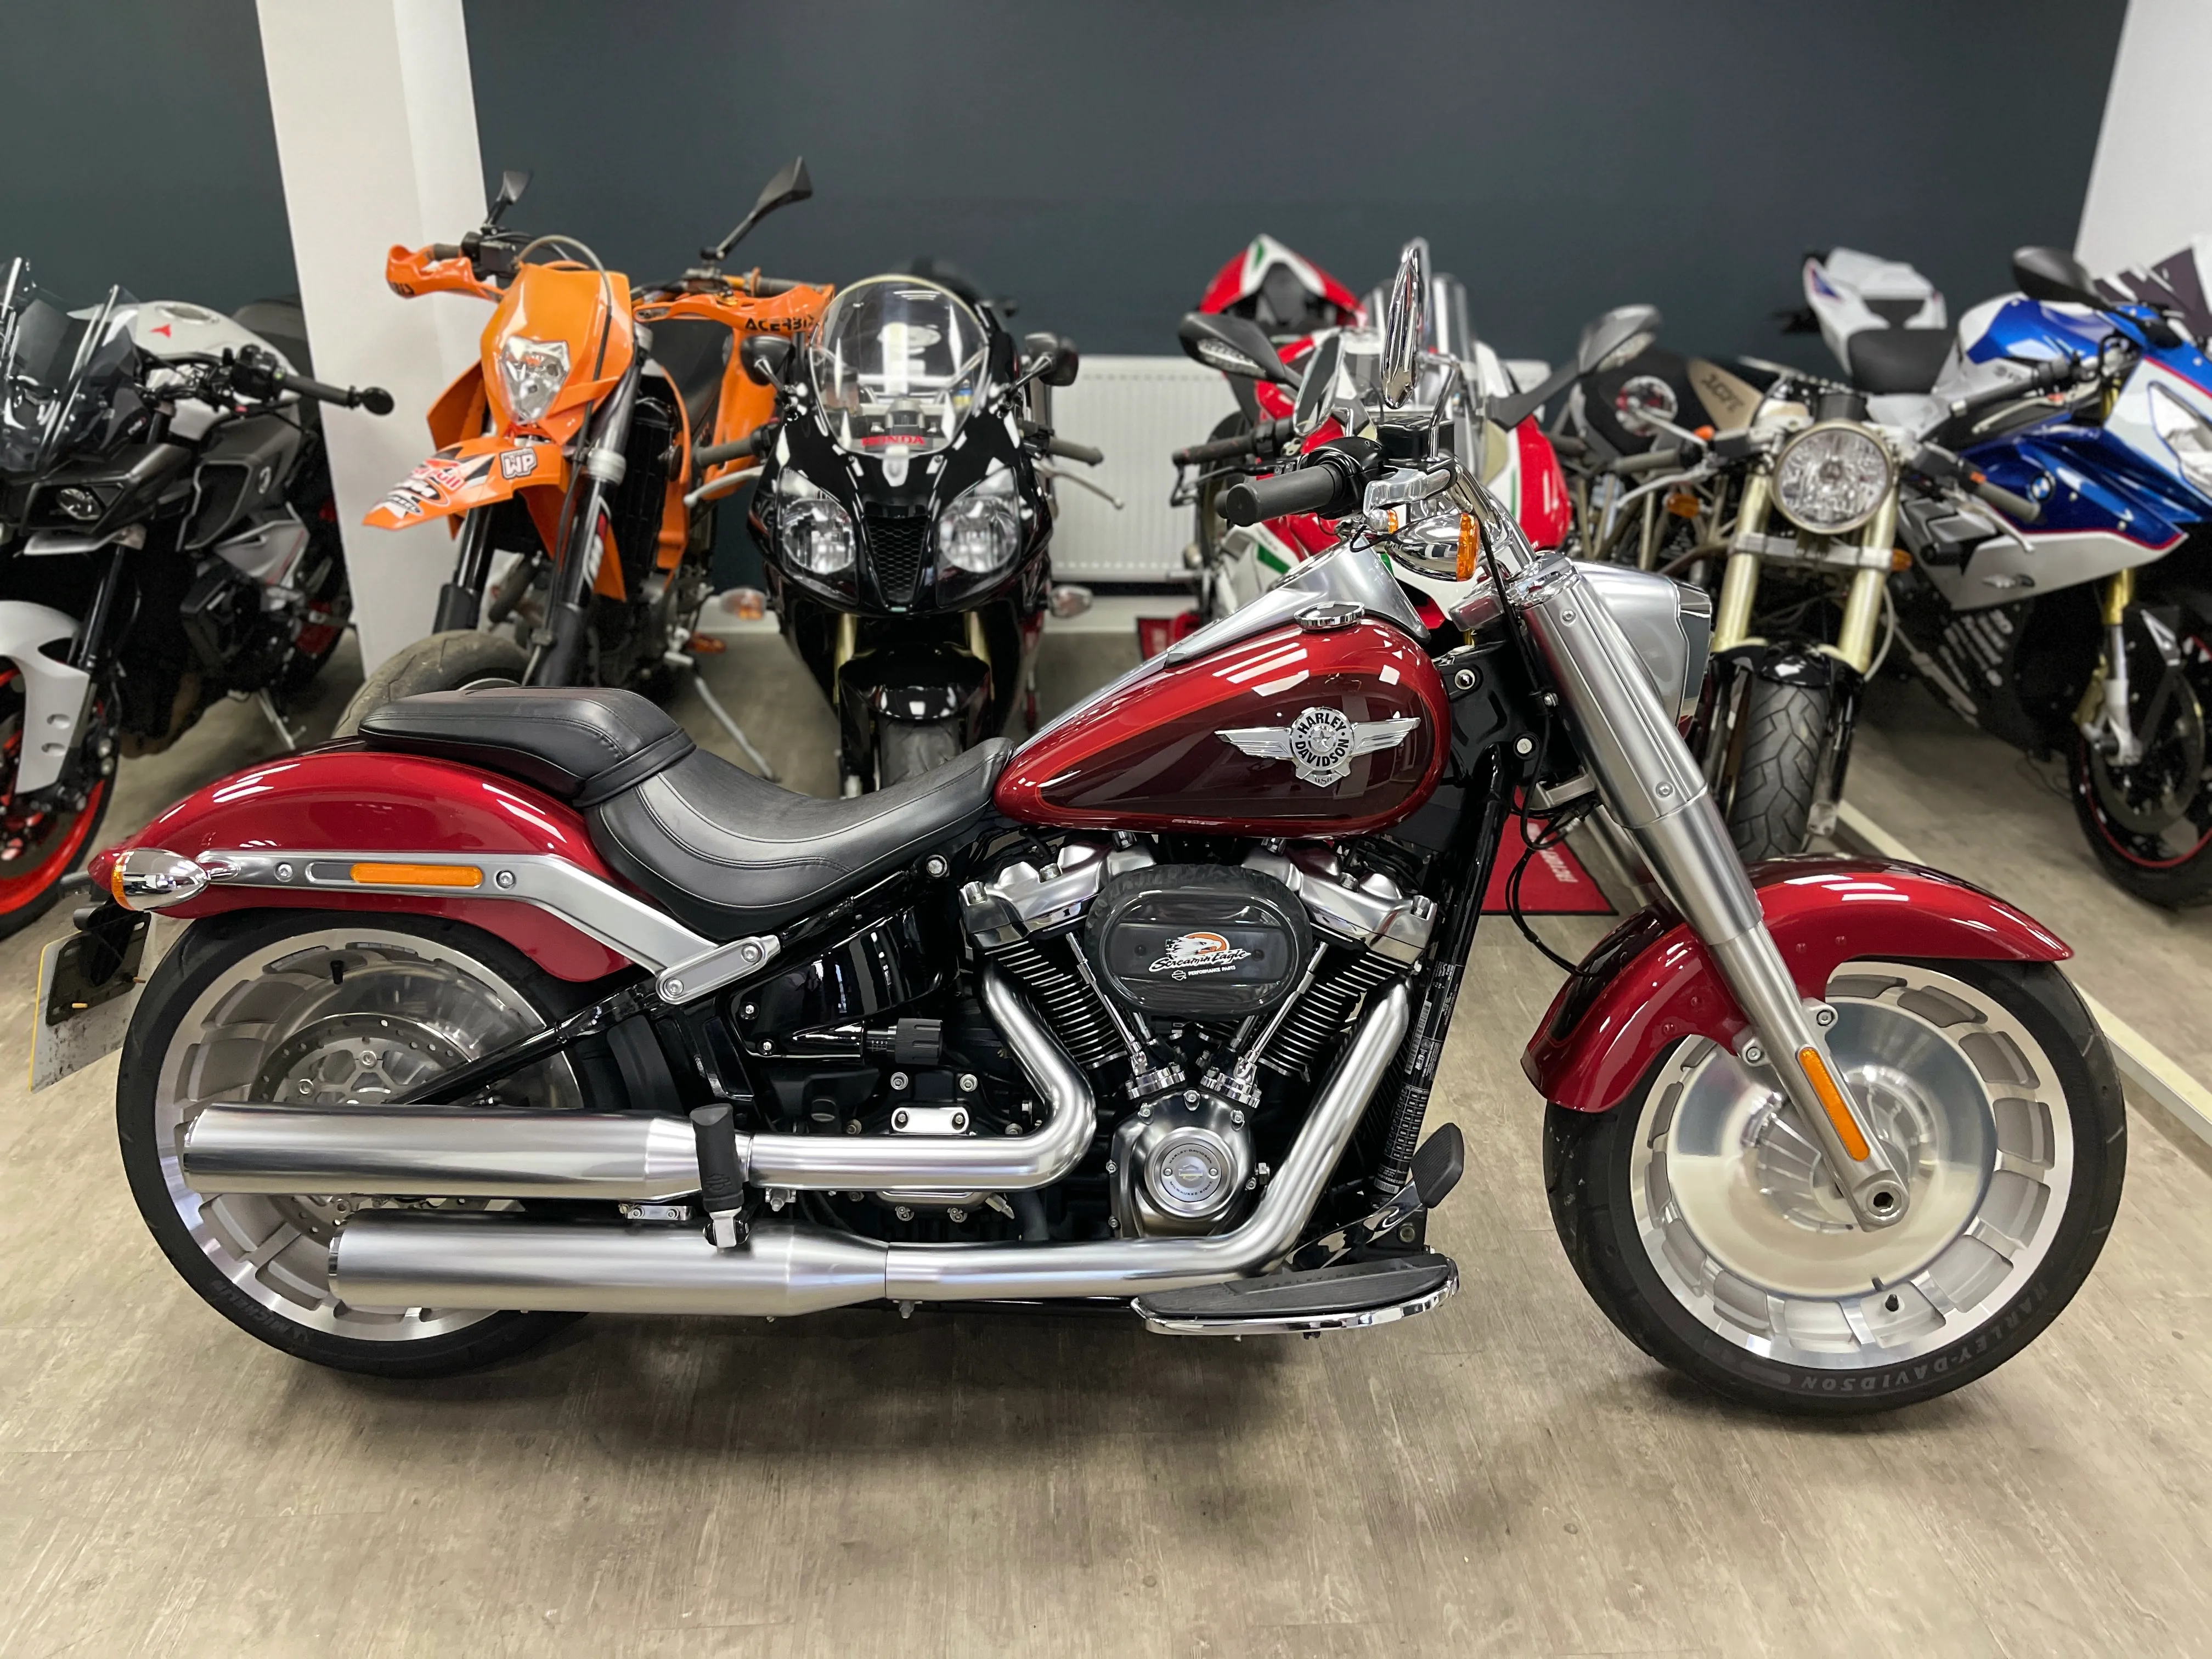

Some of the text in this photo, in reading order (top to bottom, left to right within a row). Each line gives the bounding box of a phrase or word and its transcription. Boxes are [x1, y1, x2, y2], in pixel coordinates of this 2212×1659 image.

[504, 454, 535, 476] WP
[1297, 713, 1347, 735] HARLEY
[1295, 738, 1349, 767] DAVIDSON
[1211, 951, 1246, 963] Eagle
